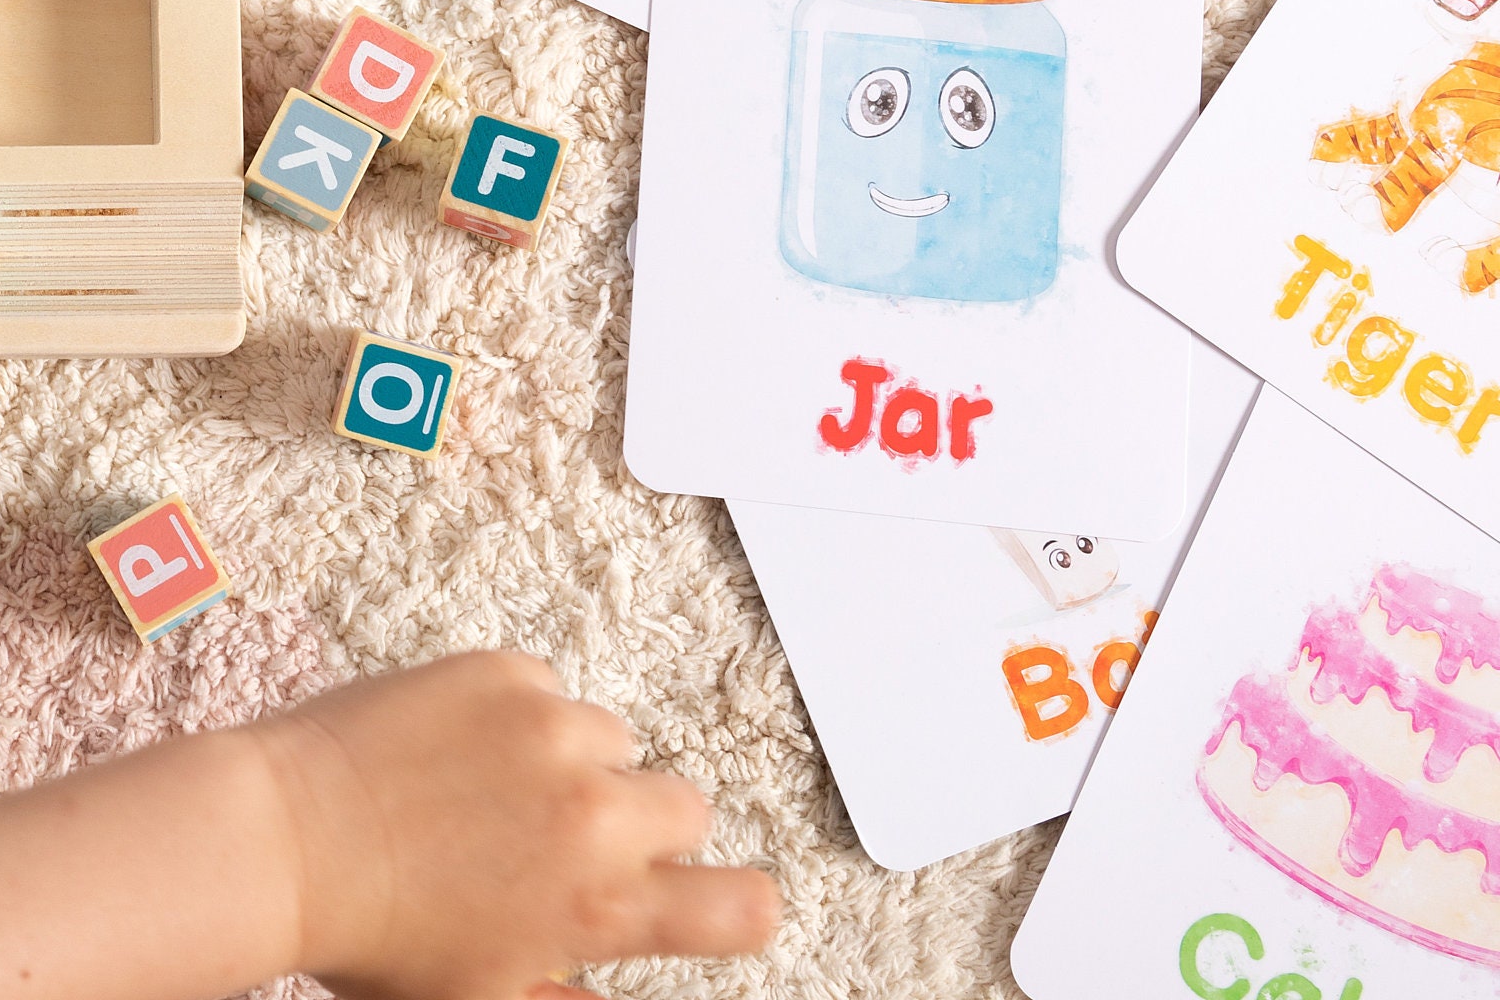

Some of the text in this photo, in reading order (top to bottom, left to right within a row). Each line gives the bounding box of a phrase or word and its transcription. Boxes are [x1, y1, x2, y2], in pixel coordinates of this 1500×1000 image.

[349, 40, 415, 103] D
[278, 125, 352, 191] K
[478, 134, 536, 195] F
[1276, 235, 1500, 444] Tiger
[358, 361, 427, 426] O
[819, 358, 994, 461] Jar
[119, 542, 191, 598] P
